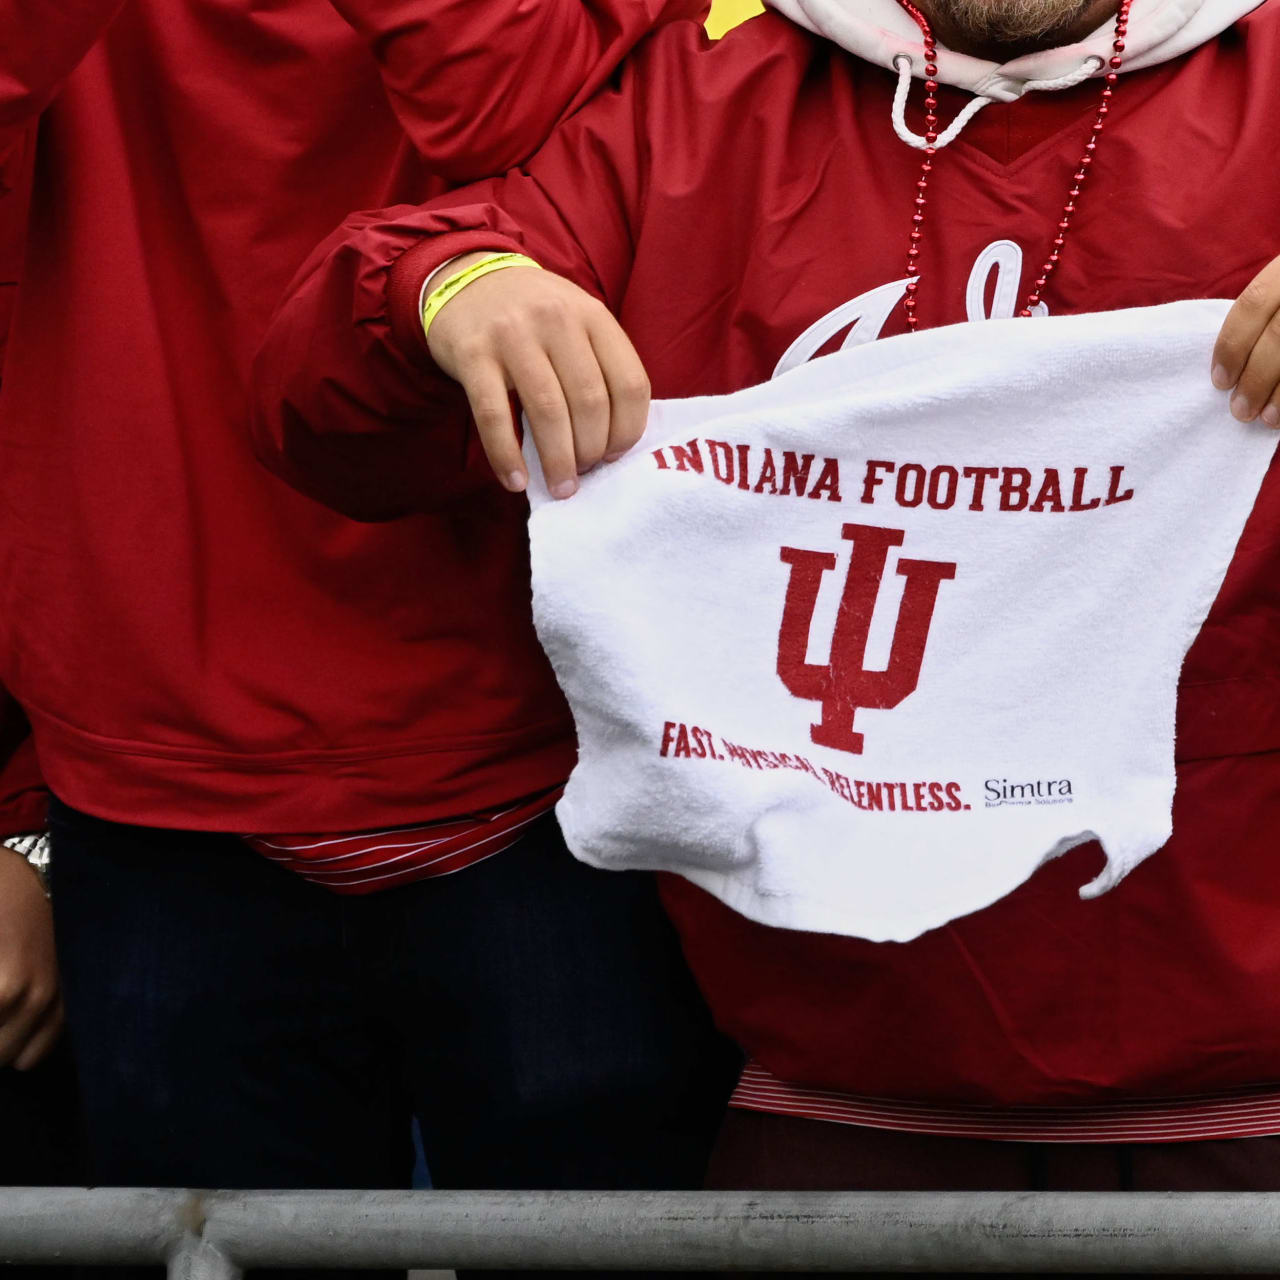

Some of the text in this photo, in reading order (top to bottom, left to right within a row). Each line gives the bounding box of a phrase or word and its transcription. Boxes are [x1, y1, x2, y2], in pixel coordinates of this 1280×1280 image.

[653, 438, 1135, 513] INDIANA FOOTBALL
[660, 721, 725, 760] FAST.
[821, 767, 972, 812] RELENTLESS.
[984, 778, 1073, 802] Simtra
